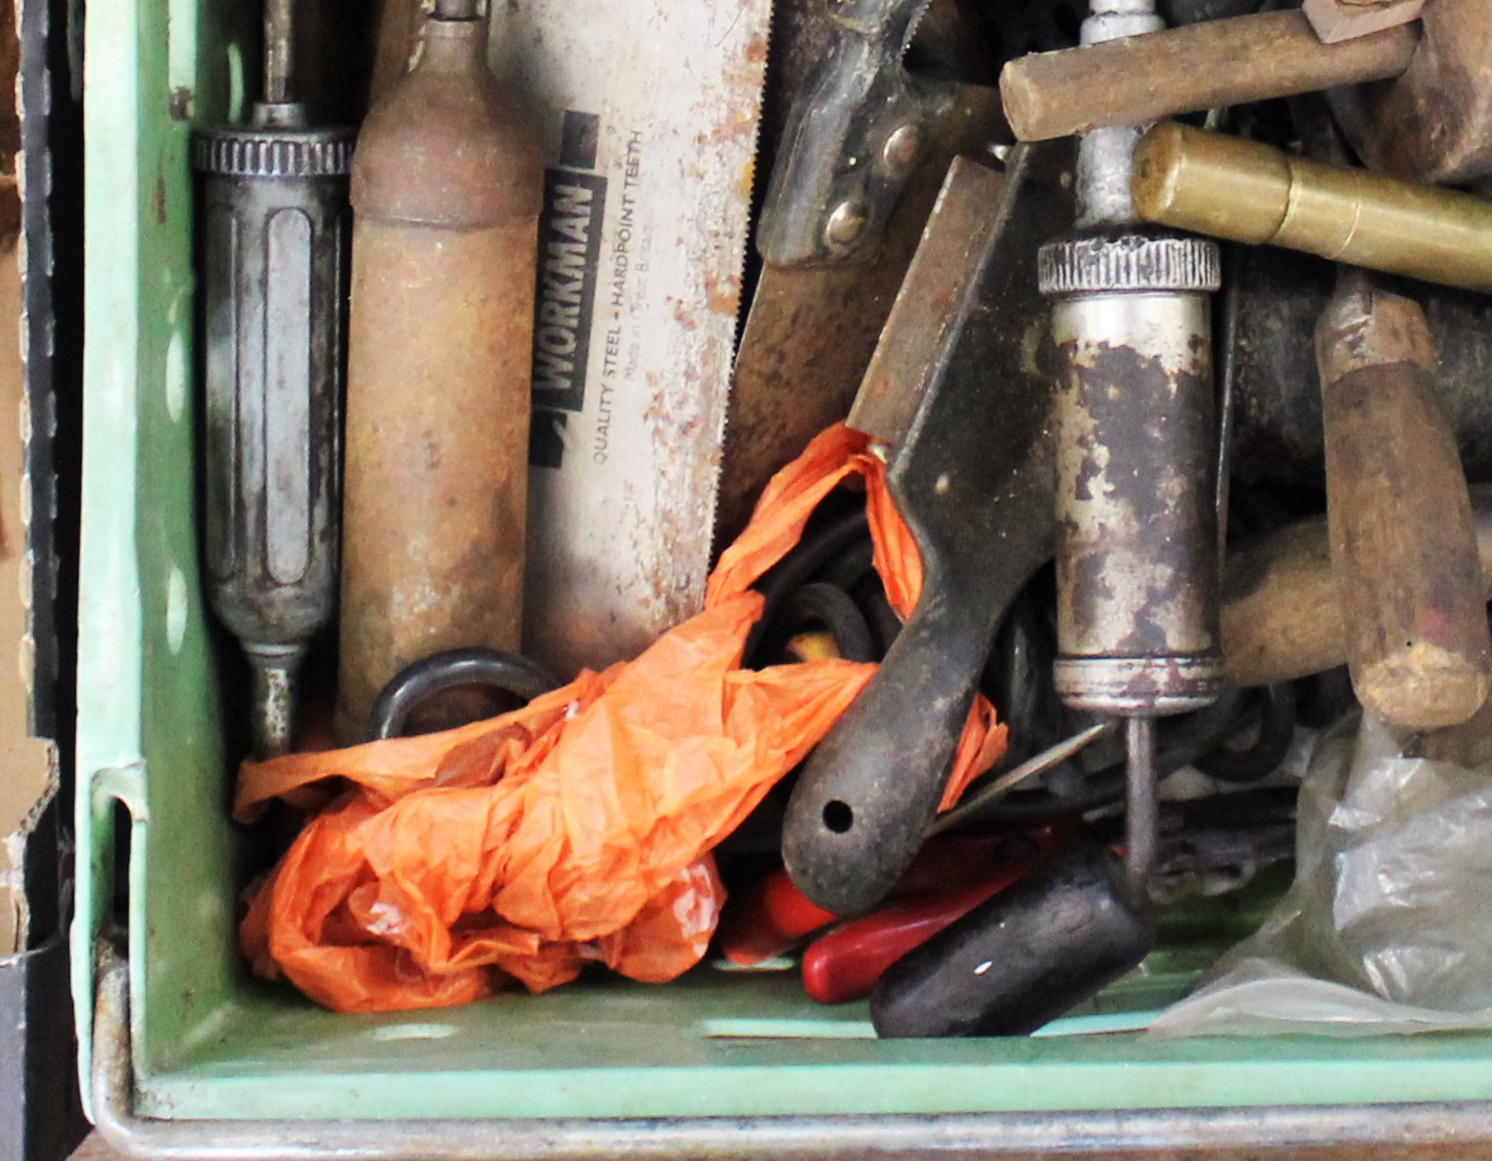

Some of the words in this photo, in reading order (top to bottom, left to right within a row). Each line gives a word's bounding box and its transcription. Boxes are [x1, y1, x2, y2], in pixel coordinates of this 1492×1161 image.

[623, 129, 643, 189] TEETH
[610, 194, 636, 306] HARDPOINT
[533, 182, 594, 392] WORKMAN
[602, 325, 622, 378] STEEL
[628, 323, 643, 337] in
[624, 341, 641, 380] Made
[593, 382, 615, 465] QUALITY
